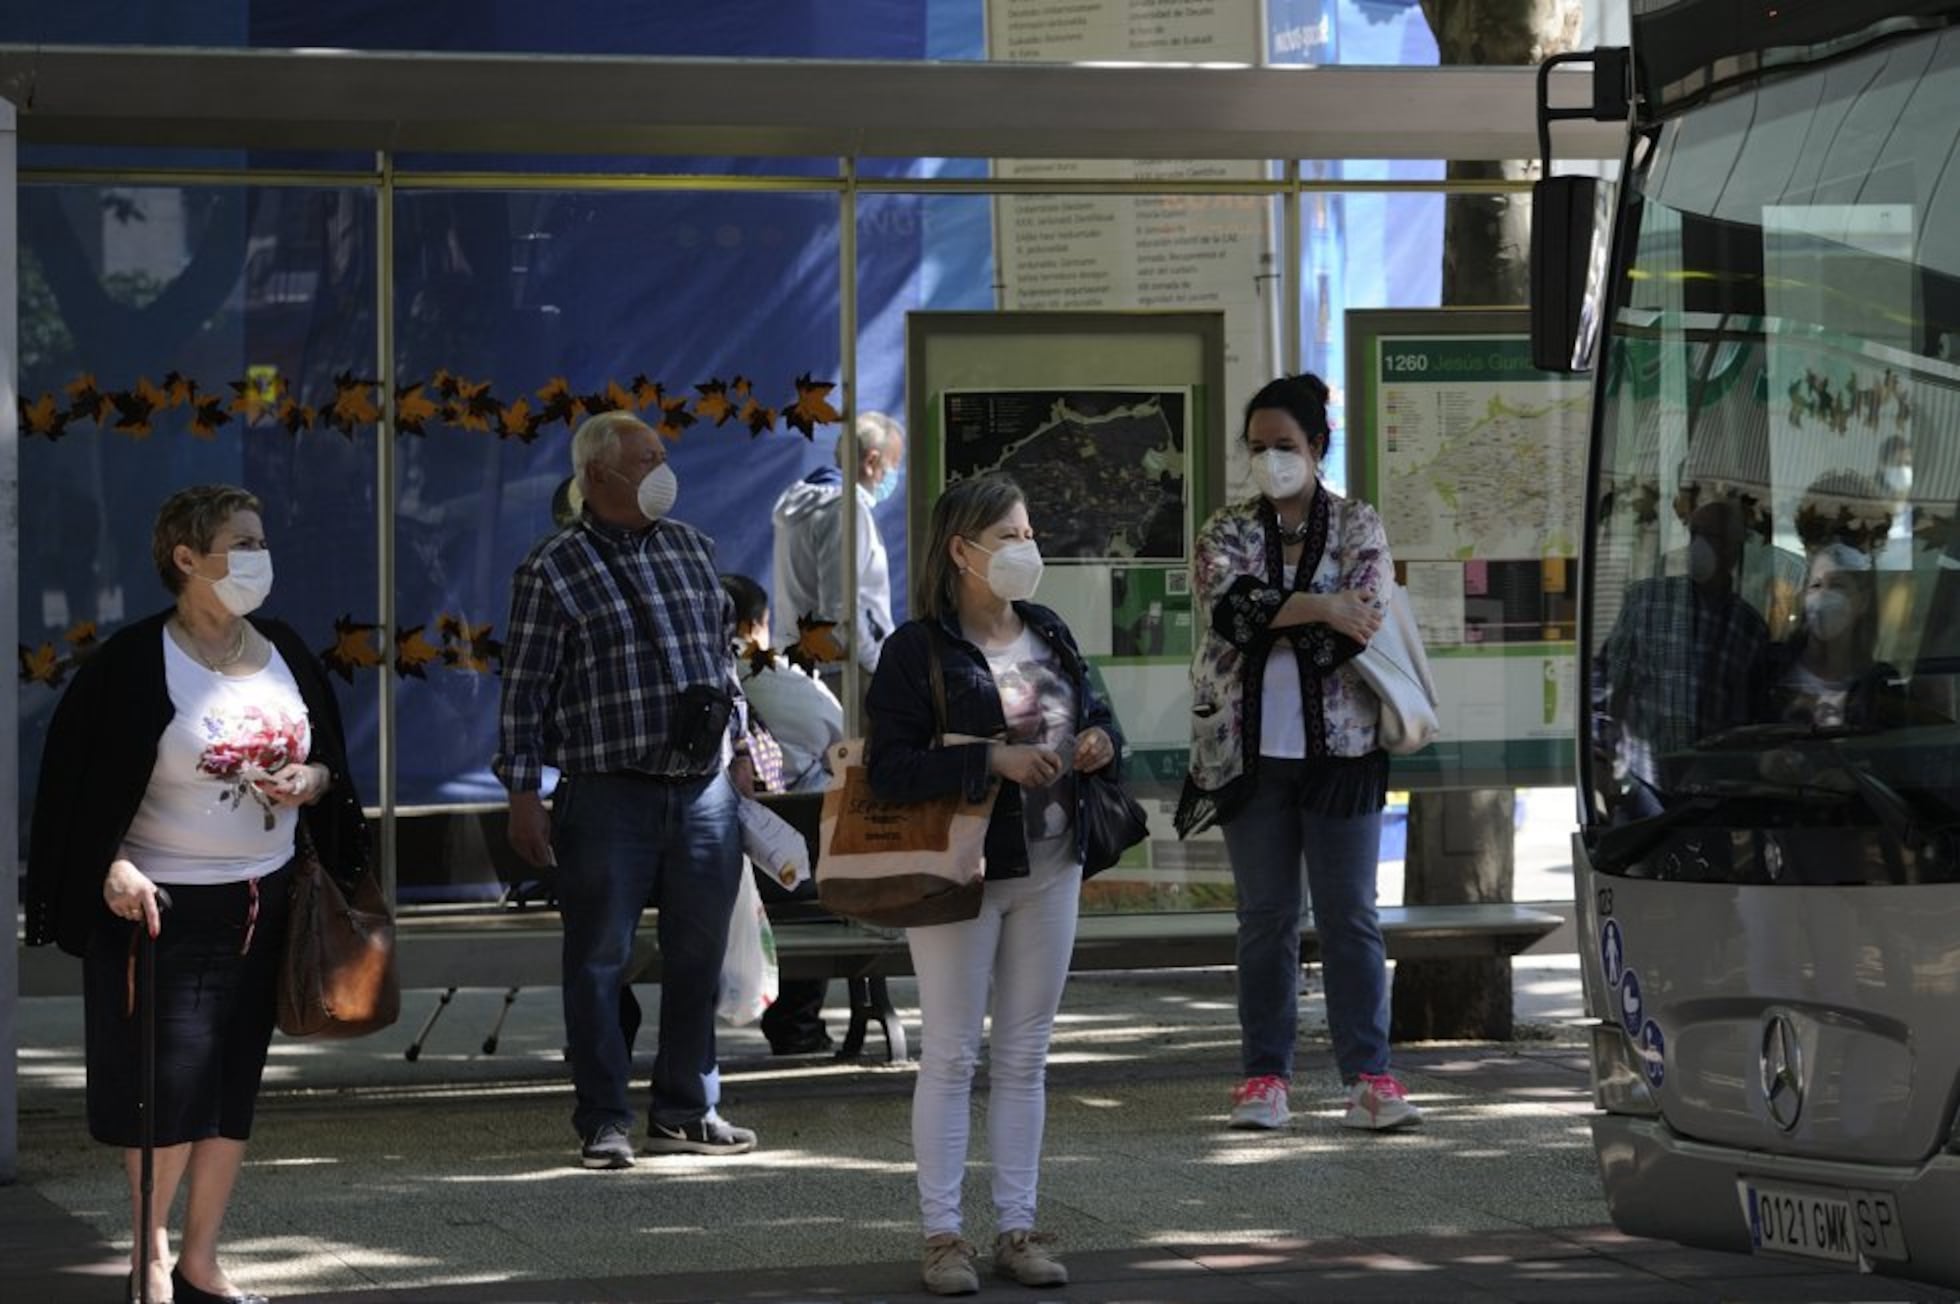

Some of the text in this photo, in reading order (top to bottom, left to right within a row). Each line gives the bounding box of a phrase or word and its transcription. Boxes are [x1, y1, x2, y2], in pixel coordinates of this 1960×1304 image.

[1384, 354, 1429, 372] 1260
[1761, 1195, 1809, 1247] 0121
[1812, 1202, 1852, 1256] GMK
[1856, 1199, 1893, 1249] SP
